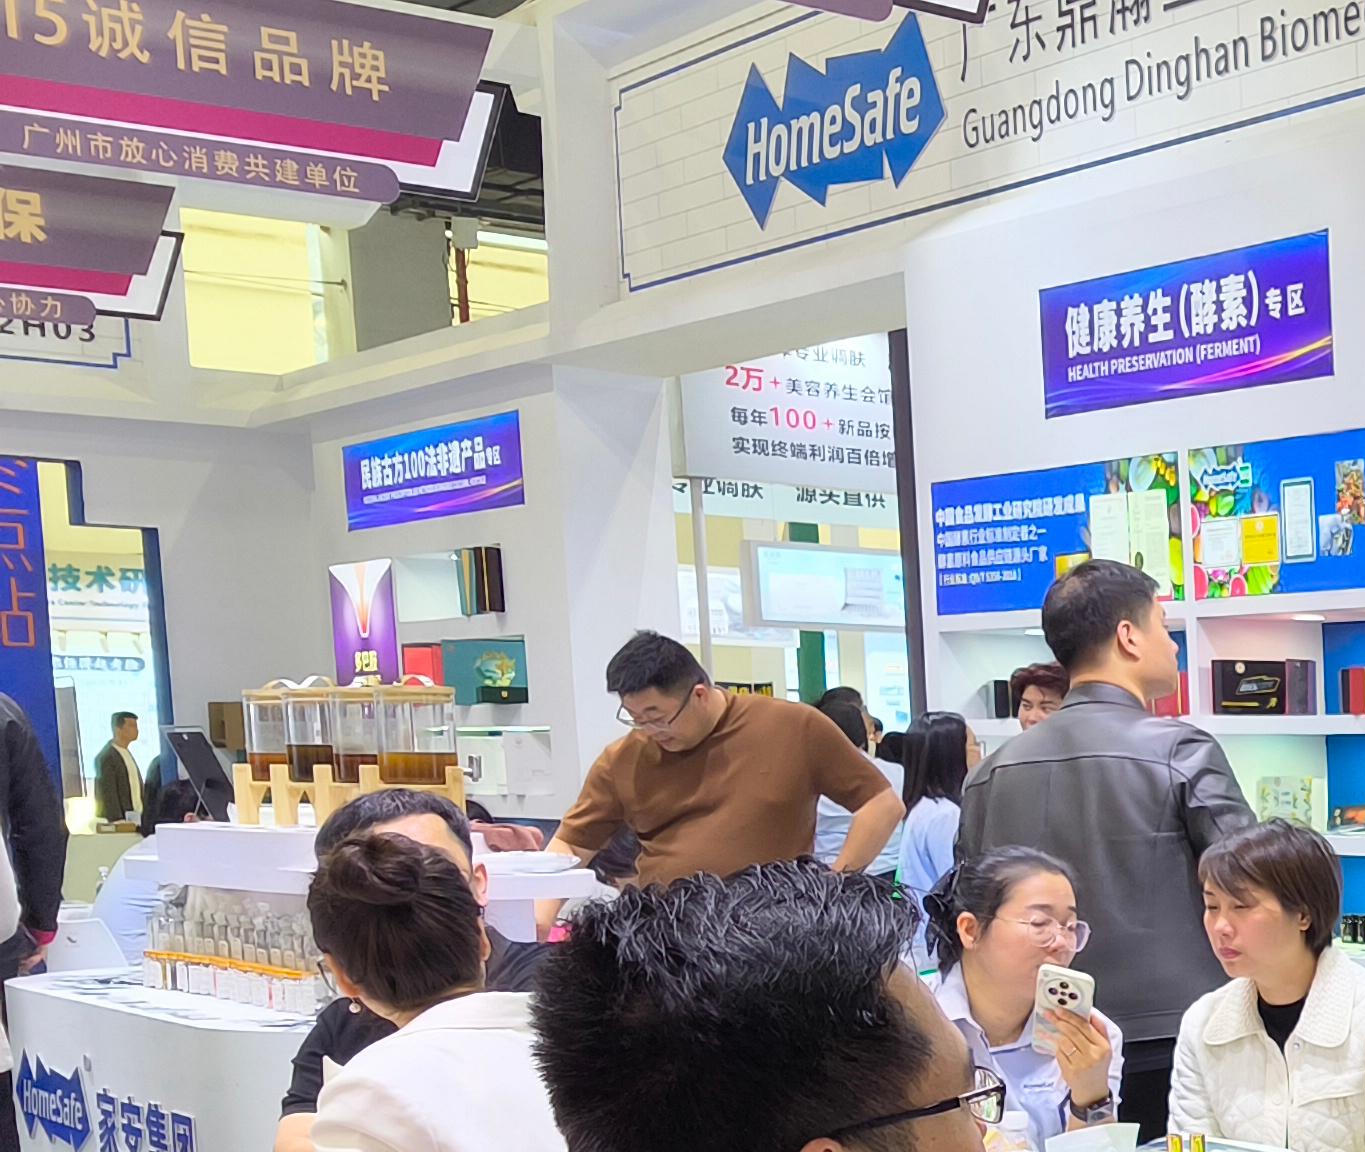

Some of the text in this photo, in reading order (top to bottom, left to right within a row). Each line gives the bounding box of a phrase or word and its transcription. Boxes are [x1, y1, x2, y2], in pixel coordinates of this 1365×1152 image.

[962, 76, 1116, 149] Guangdong
[1124, 34, 1250, 100] Dinghan
[22, 123, 361, 194] 广州市放心消费共建单位
[744, 72, 922, 187] HomeSafe
[1067, 333, 1262, 383] HEALTH PRESERVATION (FERMENT)
[22, 1077, 84, 1131] HomeSafe
